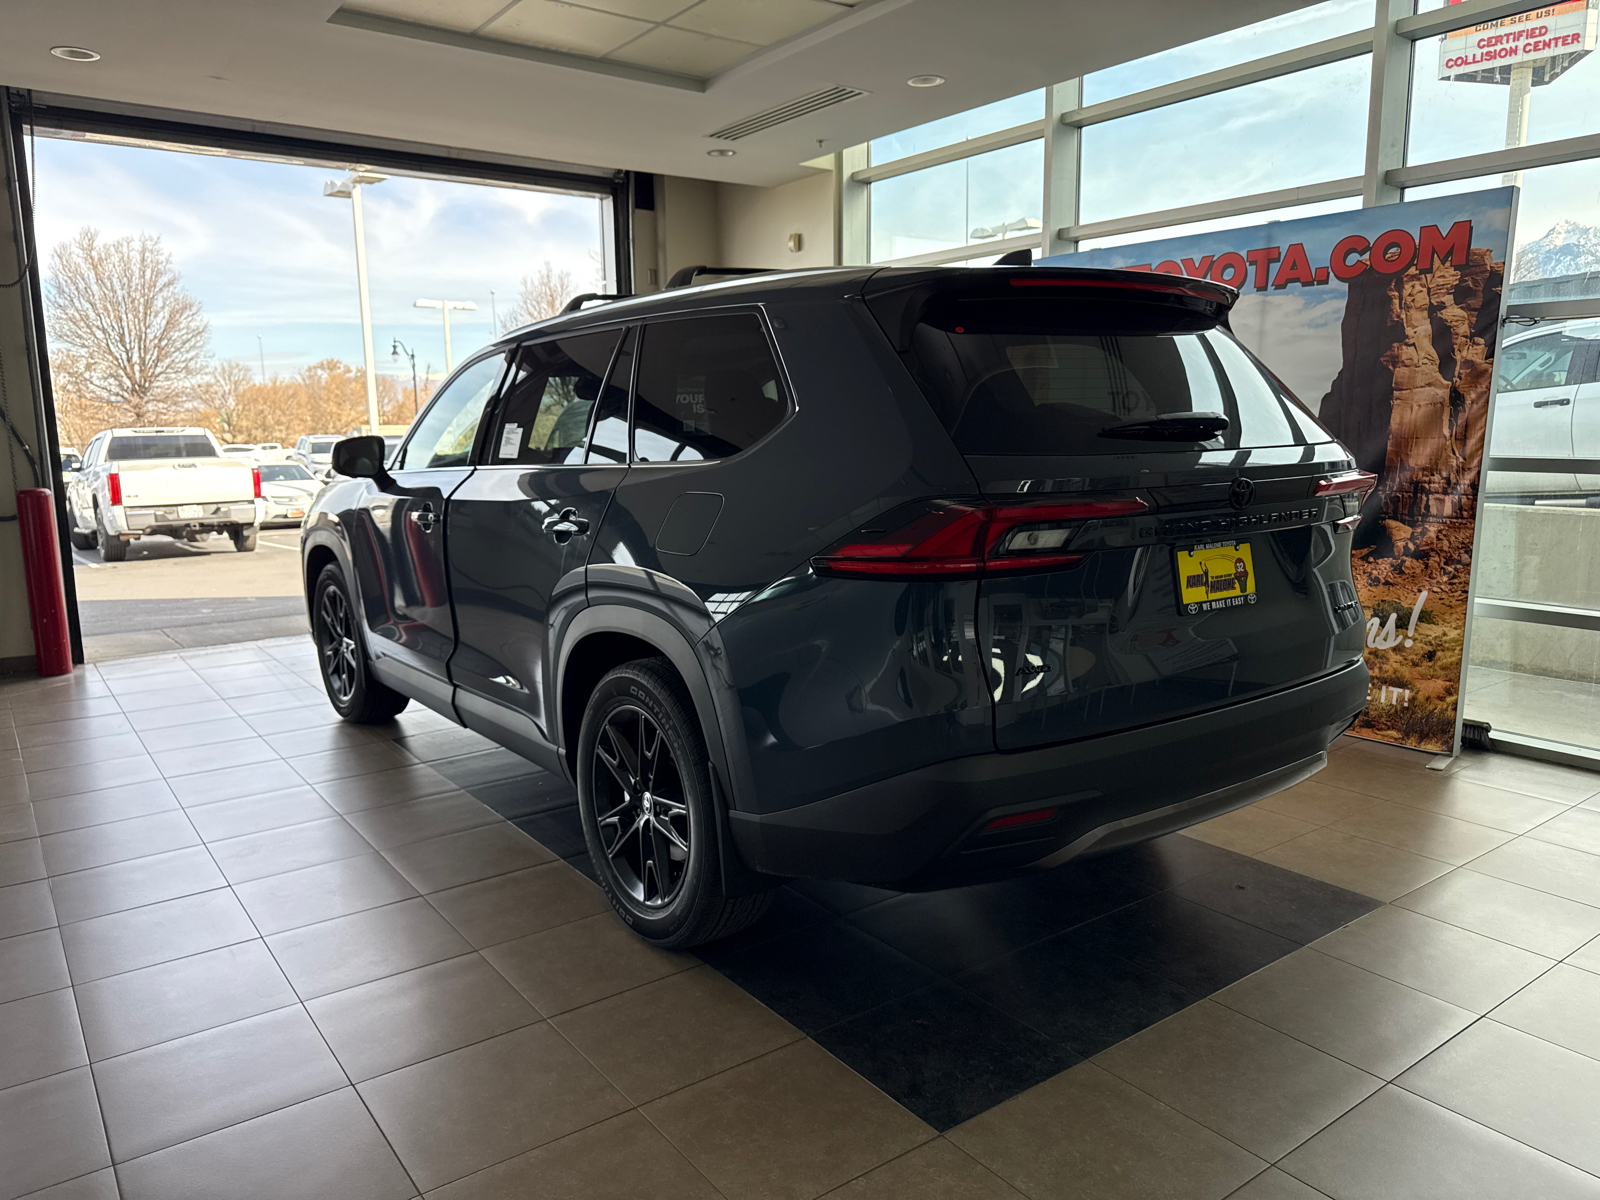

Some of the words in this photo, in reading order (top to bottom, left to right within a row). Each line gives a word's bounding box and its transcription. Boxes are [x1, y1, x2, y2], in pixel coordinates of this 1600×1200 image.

[1475, 18, 1506, 32] COME
[1510, 13, 1532, 25] SEE
[1536, 8, 1556, 20] US!
[1477, 26, 1549, 49] CERTIFIED
[1445, 45, 1518, 69] COLLISION
[1522, 32, 1581, 54] CENTER
[1123, 219, 1473, 291] YOTA.COM
[1139, 520, 1212, 539] GRAND
[1217, 508, 1319, 531] HIGHLANDER
[1236, 562, 1245, 572] 32
[1186, 573, 1205, 590] KARL
[1209, 577, 1237, 594] MALONE
[1202, 602, 1211, 611] WE
[1212, 600, 1226, 610] MAKE
[1226, 598, 1232, 607] IT
[1015, 664, 1052, 676] AWD
[1380, 685, 1410, 707] IT!
